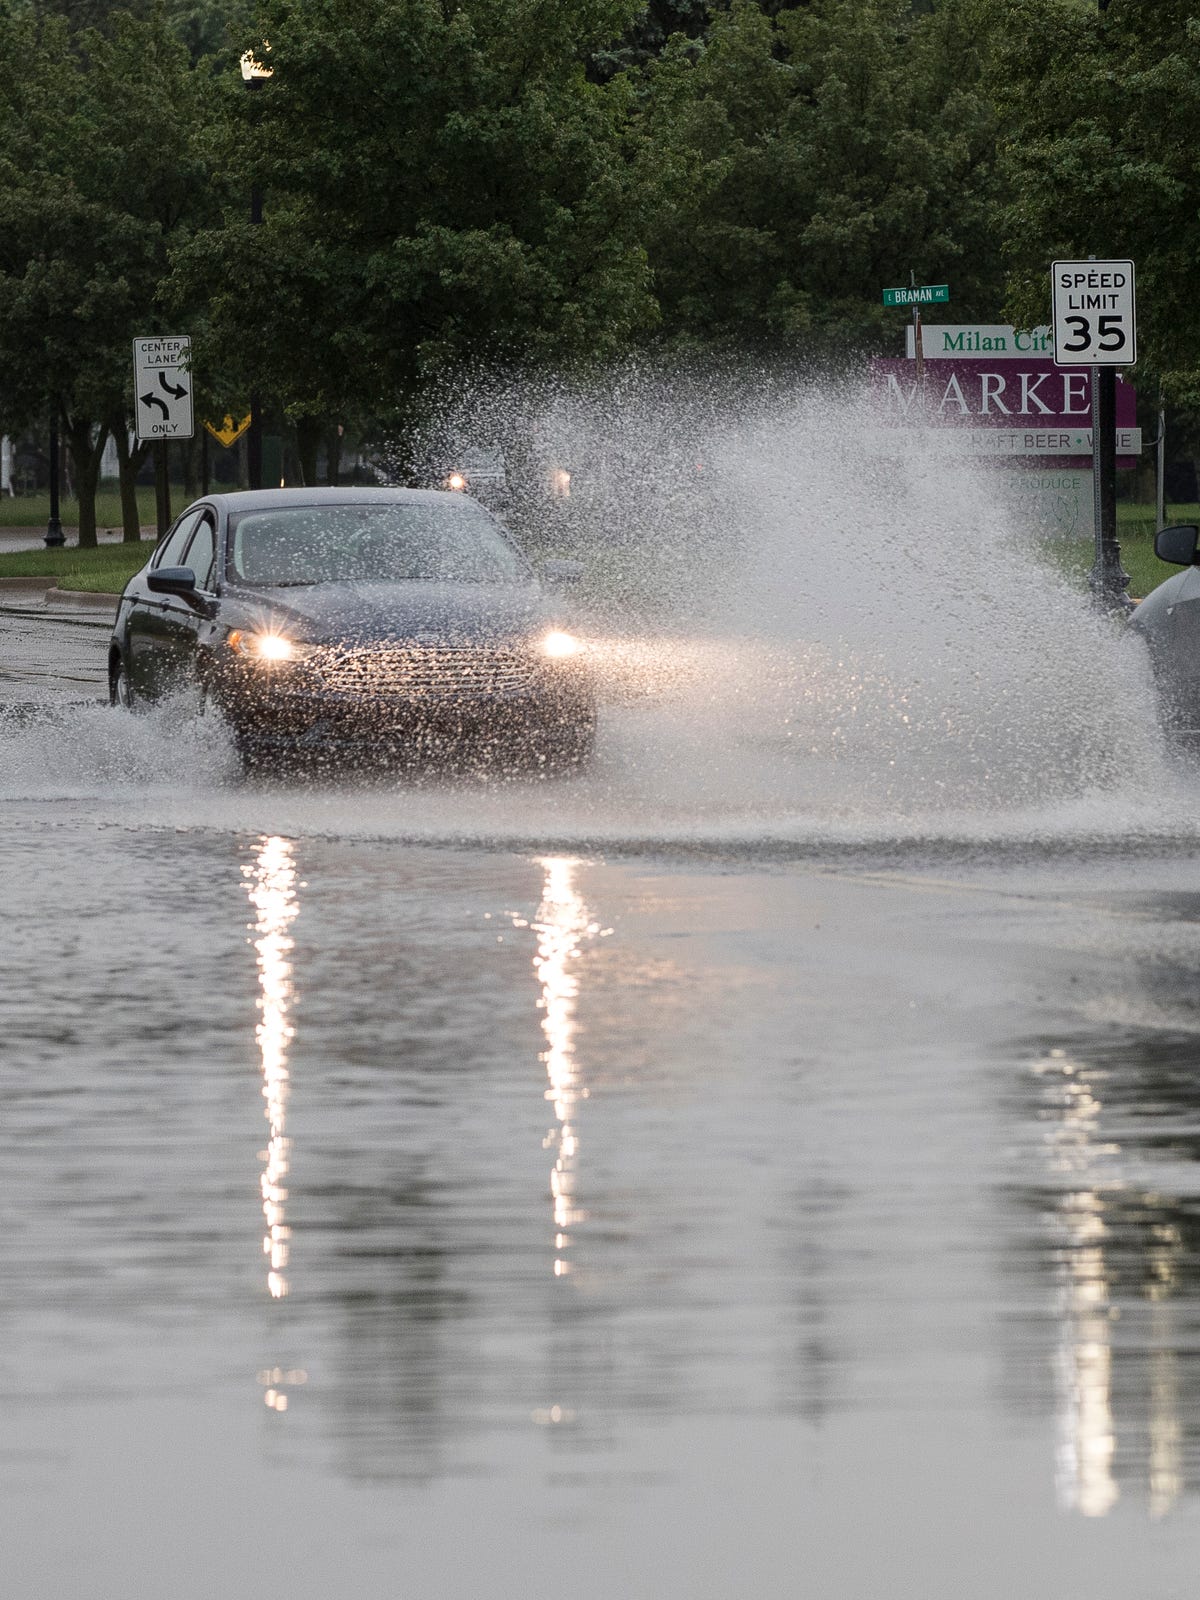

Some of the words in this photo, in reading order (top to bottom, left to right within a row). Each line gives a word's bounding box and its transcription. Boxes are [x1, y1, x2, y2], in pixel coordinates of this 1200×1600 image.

[1060, 273, 1126, 289] SPEED
[888, 294, 892, 302] E
[895, 289, 933, 303] BRAMAN
[1068, 294, 1119, 310] LIMIT
[1063, 315, 1126, 352] 35
[141, 342, 180, 352] CENTER
[942, 331, 1008, 351] Milan
[1014, 330, 1055, 356] Cit
[147, 354, 177, 364] LANE
[884, 373, 1124, 415] MARKE
[152, 424, 179, 433] ONLY
[1024, 434, 1070, 448] BEER
